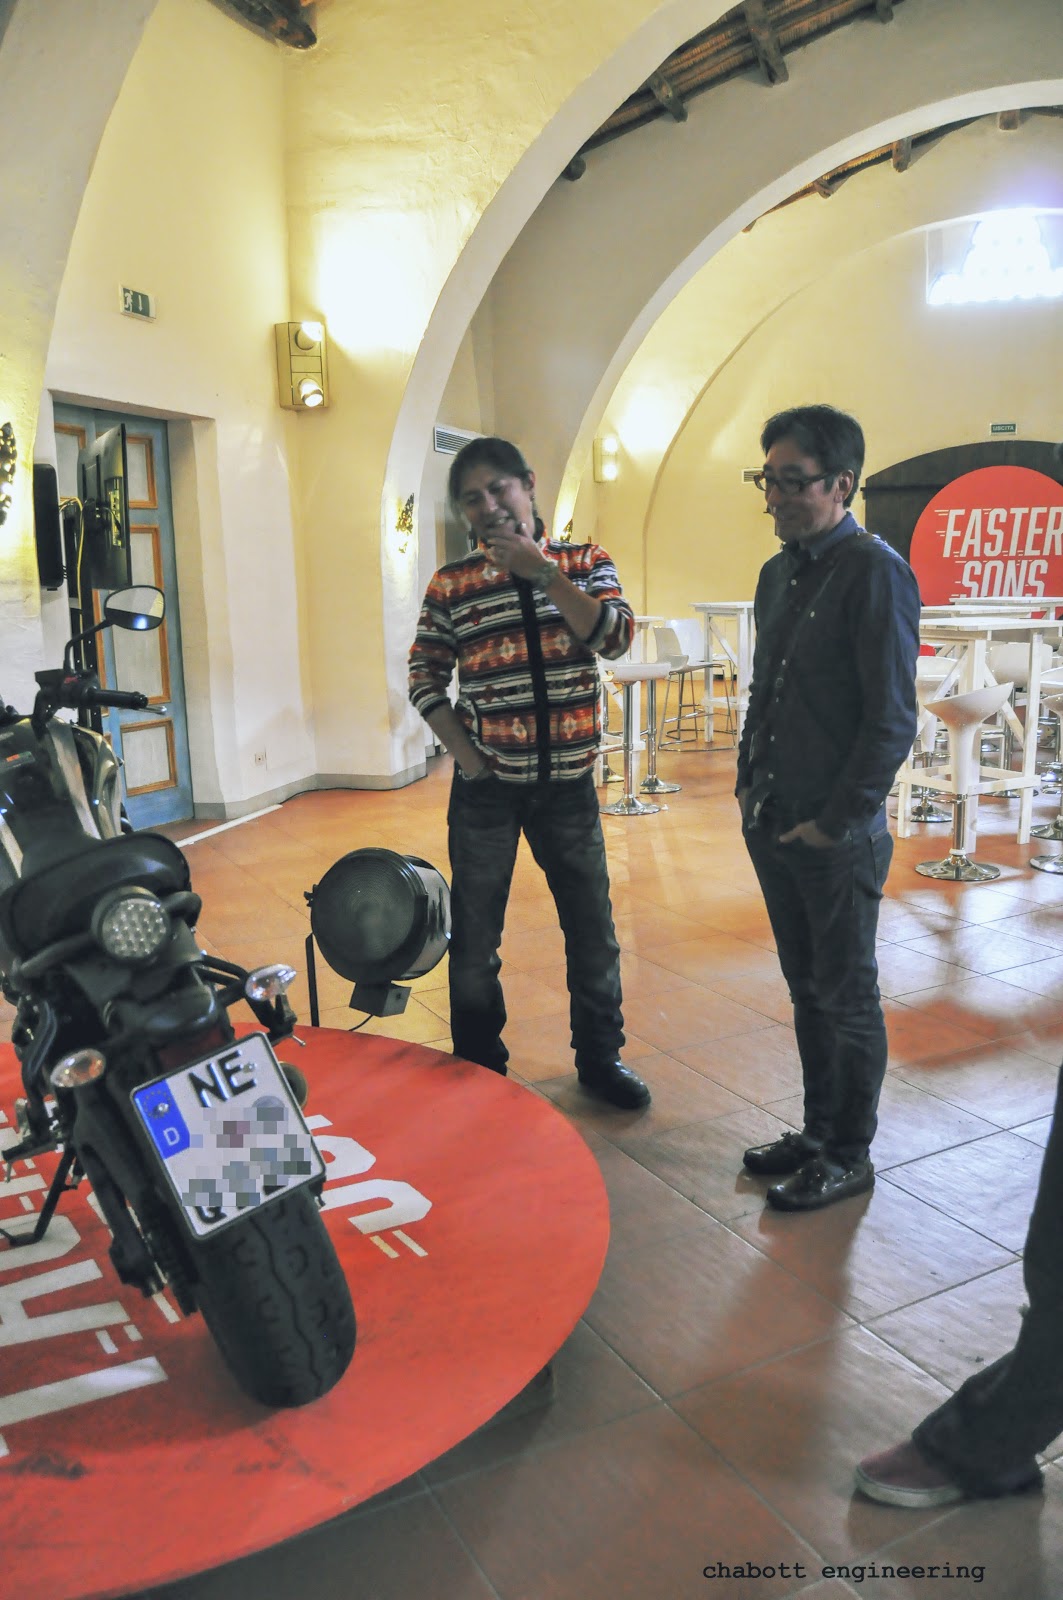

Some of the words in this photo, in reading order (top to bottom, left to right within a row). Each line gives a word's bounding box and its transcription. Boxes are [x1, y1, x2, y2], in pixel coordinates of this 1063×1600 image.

[942, 507, 1063, 558] FASTER
[960, 560, 1048, 597] SONS
[189, 1049, 257, 1108] NE
[163, 1127, 180, 1146] D
